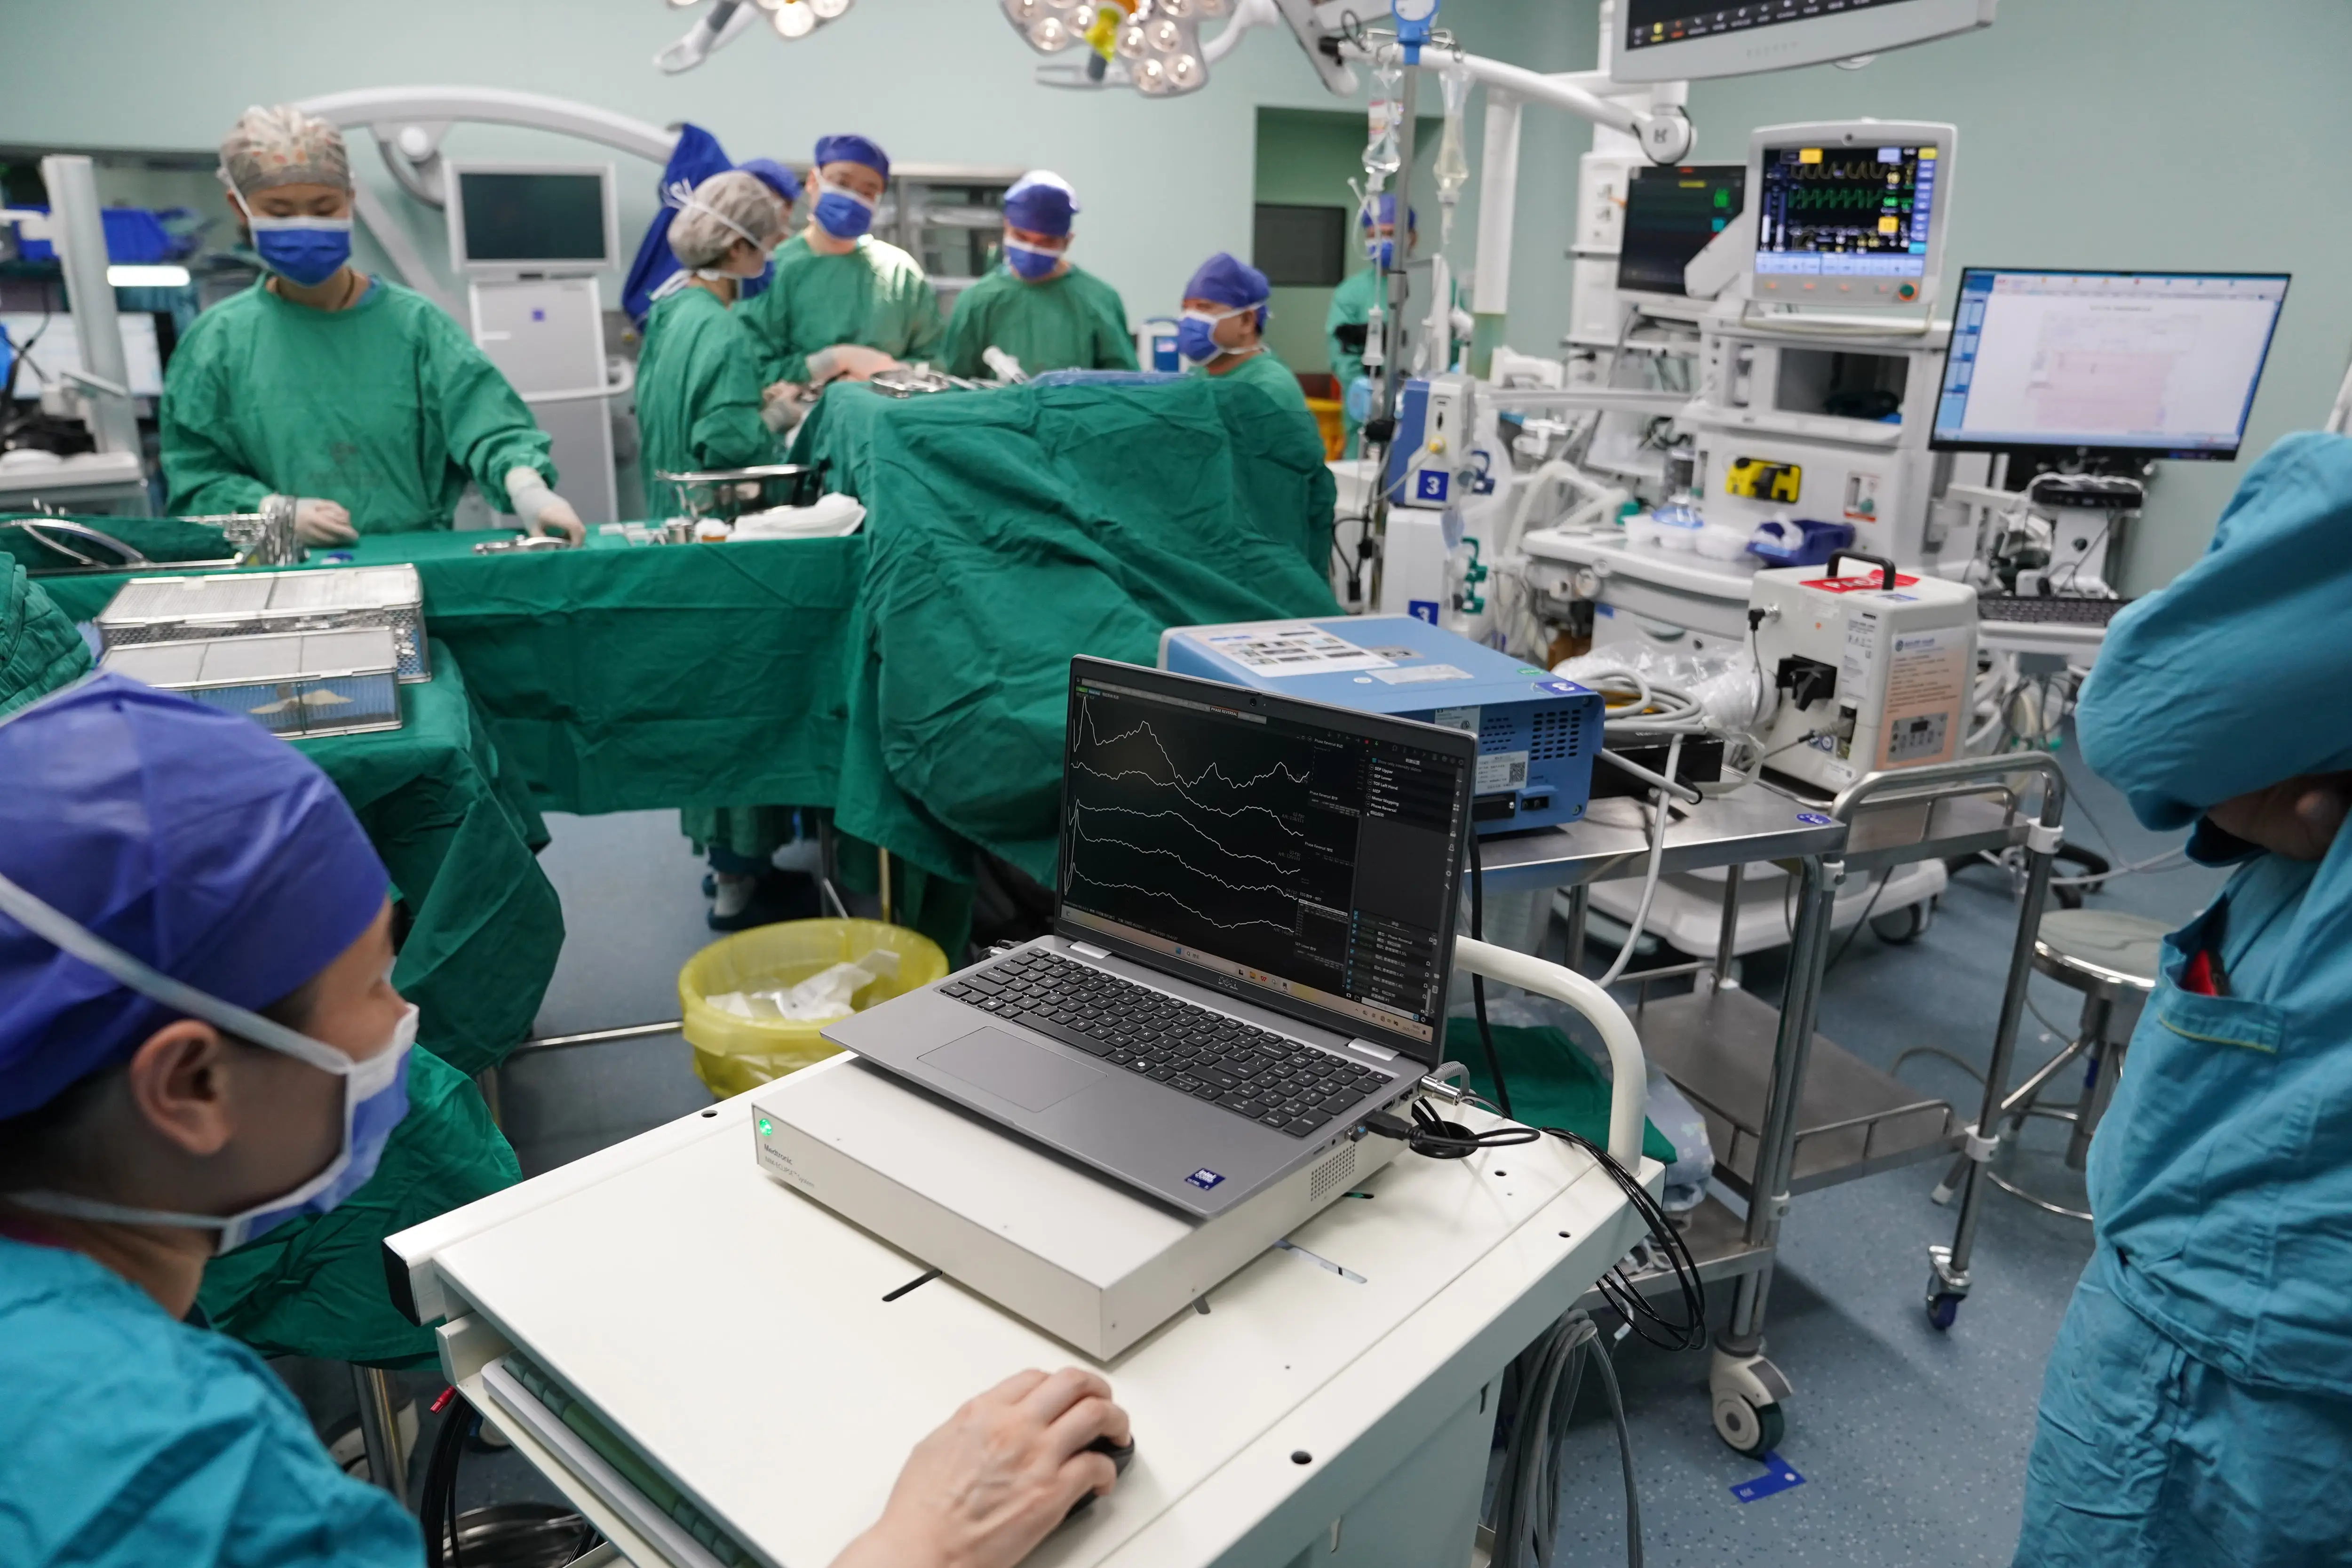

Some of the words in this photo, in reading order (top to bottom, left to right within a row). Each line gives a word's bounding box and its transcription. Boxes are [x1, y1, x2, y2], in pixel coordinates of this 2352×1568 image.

[1426, 476, 1440, 495] 3
[1383, 798, 1399, 807] Mapping
[764, 1144, 793, 1165] Medtronic
